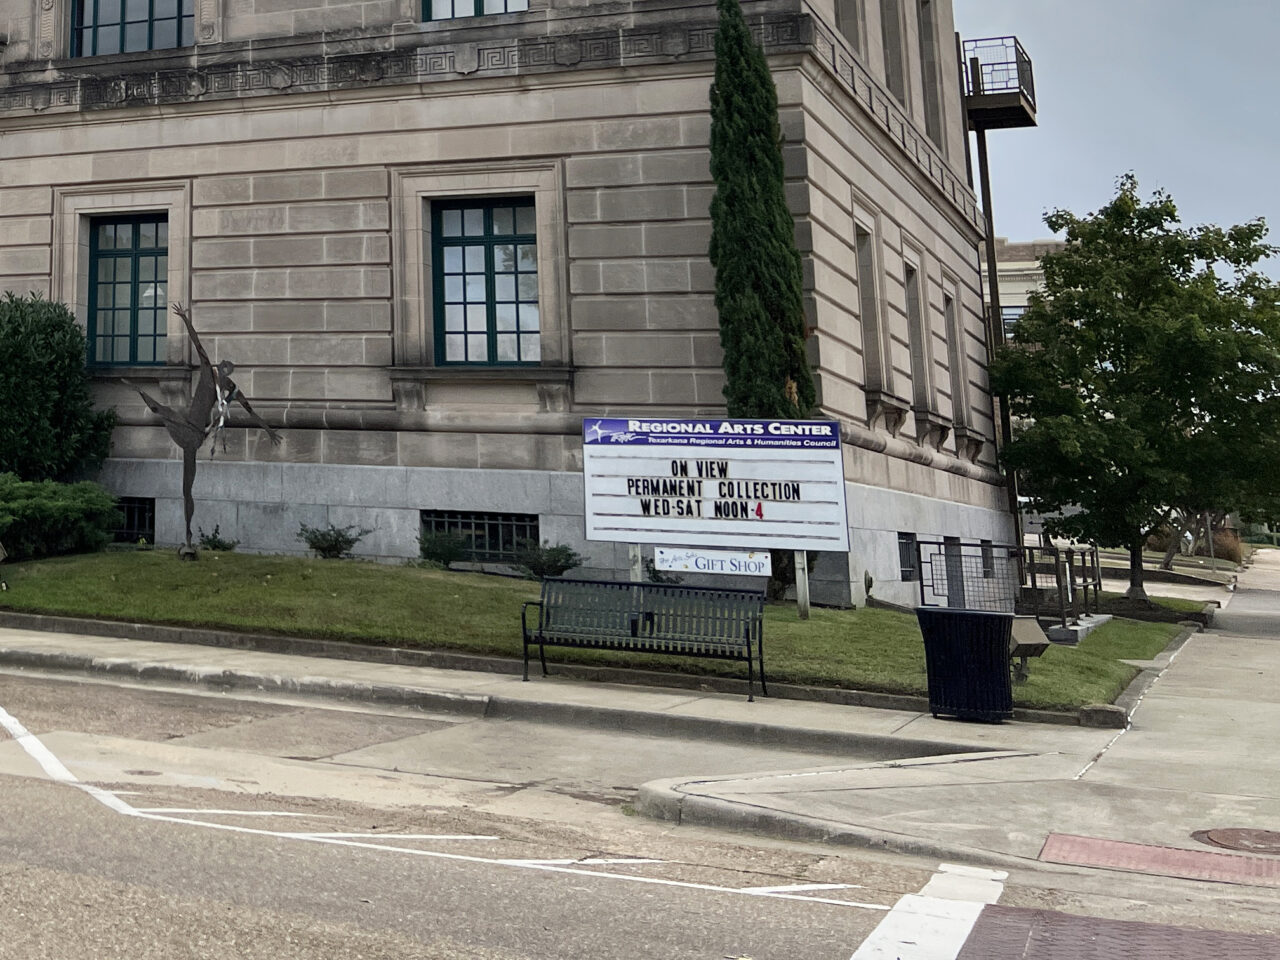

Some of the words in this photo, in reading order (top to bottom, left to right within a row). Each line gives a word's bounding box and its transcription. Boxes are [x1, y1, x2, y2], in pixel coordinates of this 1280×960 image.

[628, 419, 714, 433] REGIONAL
[718, 422, 765, 435] ARTS
[768, 422, 833, 436] CENTER
[647, 436, 688, 444] Texarkana
[689, 437, 725, 445] Regional
[754, 438, 801, 446] Humanities
[803, 439, 837, 447] Council
[671, 459, 689, 477] ON
[696, 460, 729, 479] VIEW
[627, 478, 703, 497] PERMANENT
[718, 481, 801, 501] COLLECTION
[640, 498, 703, 517] WED-SAT
[695, 556, 727, 571] GIFT
[729, 557, 765, 573] SHOP
